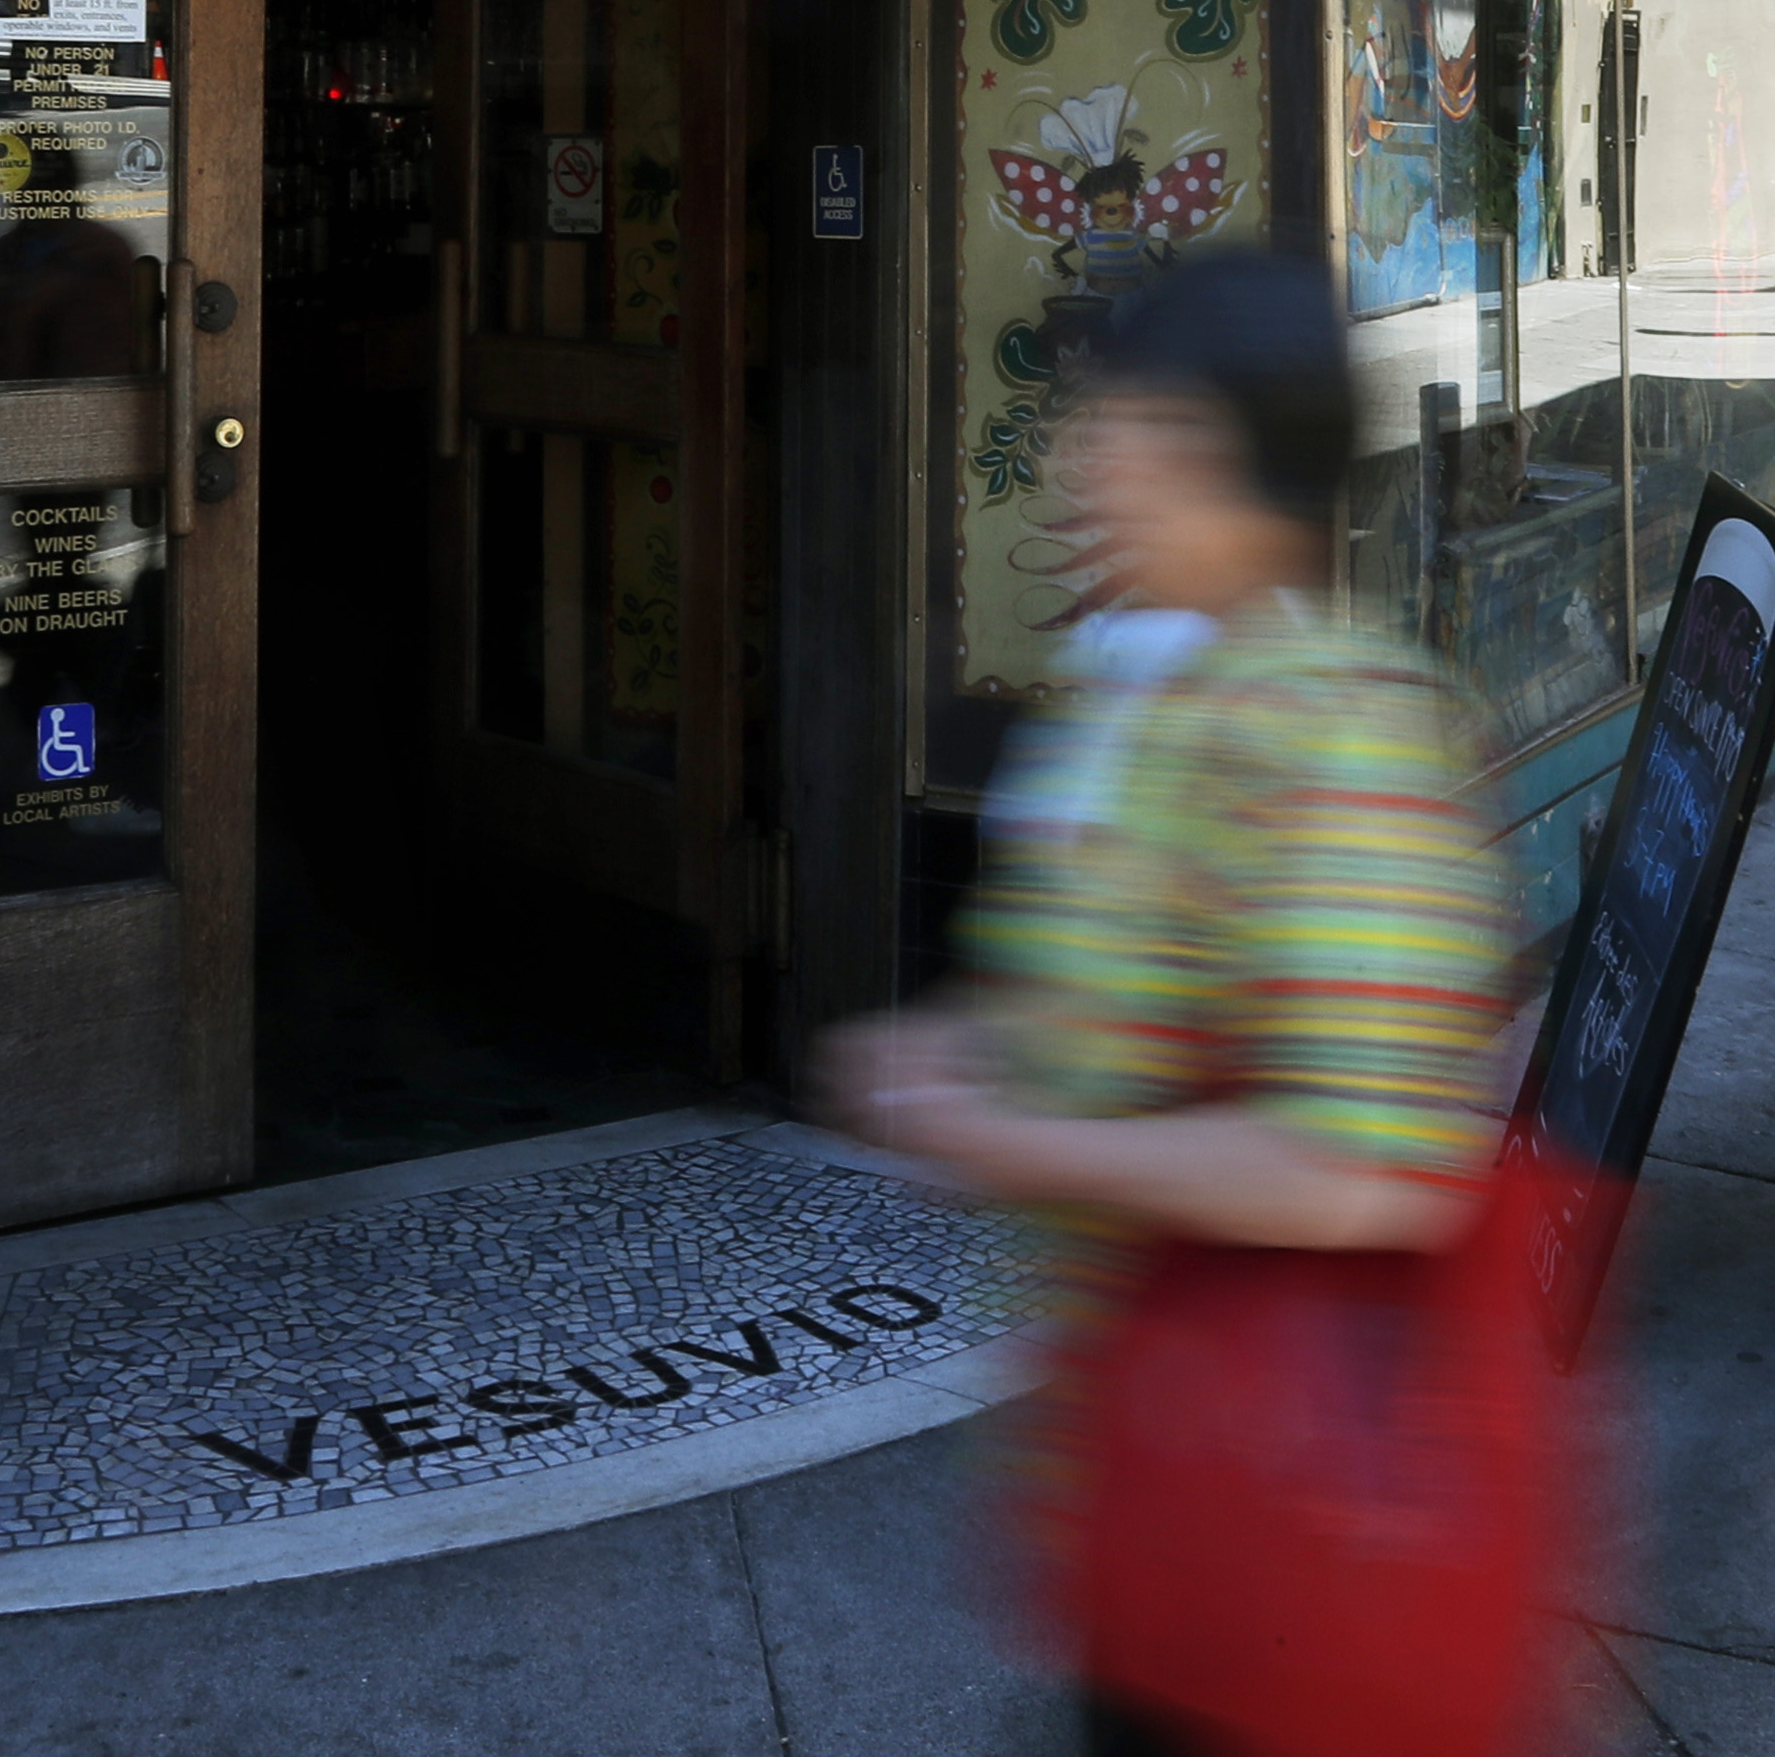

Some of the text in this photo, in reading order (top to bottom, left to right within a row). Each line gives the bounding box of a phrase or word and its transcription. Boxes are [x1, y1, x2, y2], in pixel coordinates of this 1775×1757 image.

[53, 0, 63, 8] at
[89, 0, 101, 9] 15
[116, 0, 138, 9] from
[3, 20, 44, 32] operable
[93, 21, 111, 31] and
[112, 23, 137, 33] vents
[25, 47, 115, 60] NO PERSON
[30, 63, 110, 76] UNDER 21
[32, 96, 107, 109] PREMISES
[63, 121, 112, 134] PHOTO
[118, 121, 141, 135] I.D.
[30, 137, 107, 150] REQUIRED
[2, 189, 97, 203] RESTROOMS
[820, 197, 856, 208] DISABLED
[823, 209, 854, 220] ACCESS
[10, 505, 118, 527] COCKTAILS
[34, 534, 98, 553] WINES
[26, 560, 64, 578] THE
[71, 557, 138, 576] GLA
[4, 589, 122, 613] NINE BEERS
[36, 609, 129, 631] DRAUGHT
[16, 784, 109, 806] EXHIBITS BY
[2, 800, 121, 825] LOCAL ARTISTS
[189, 1280, 946, 1486] VESUVIO
